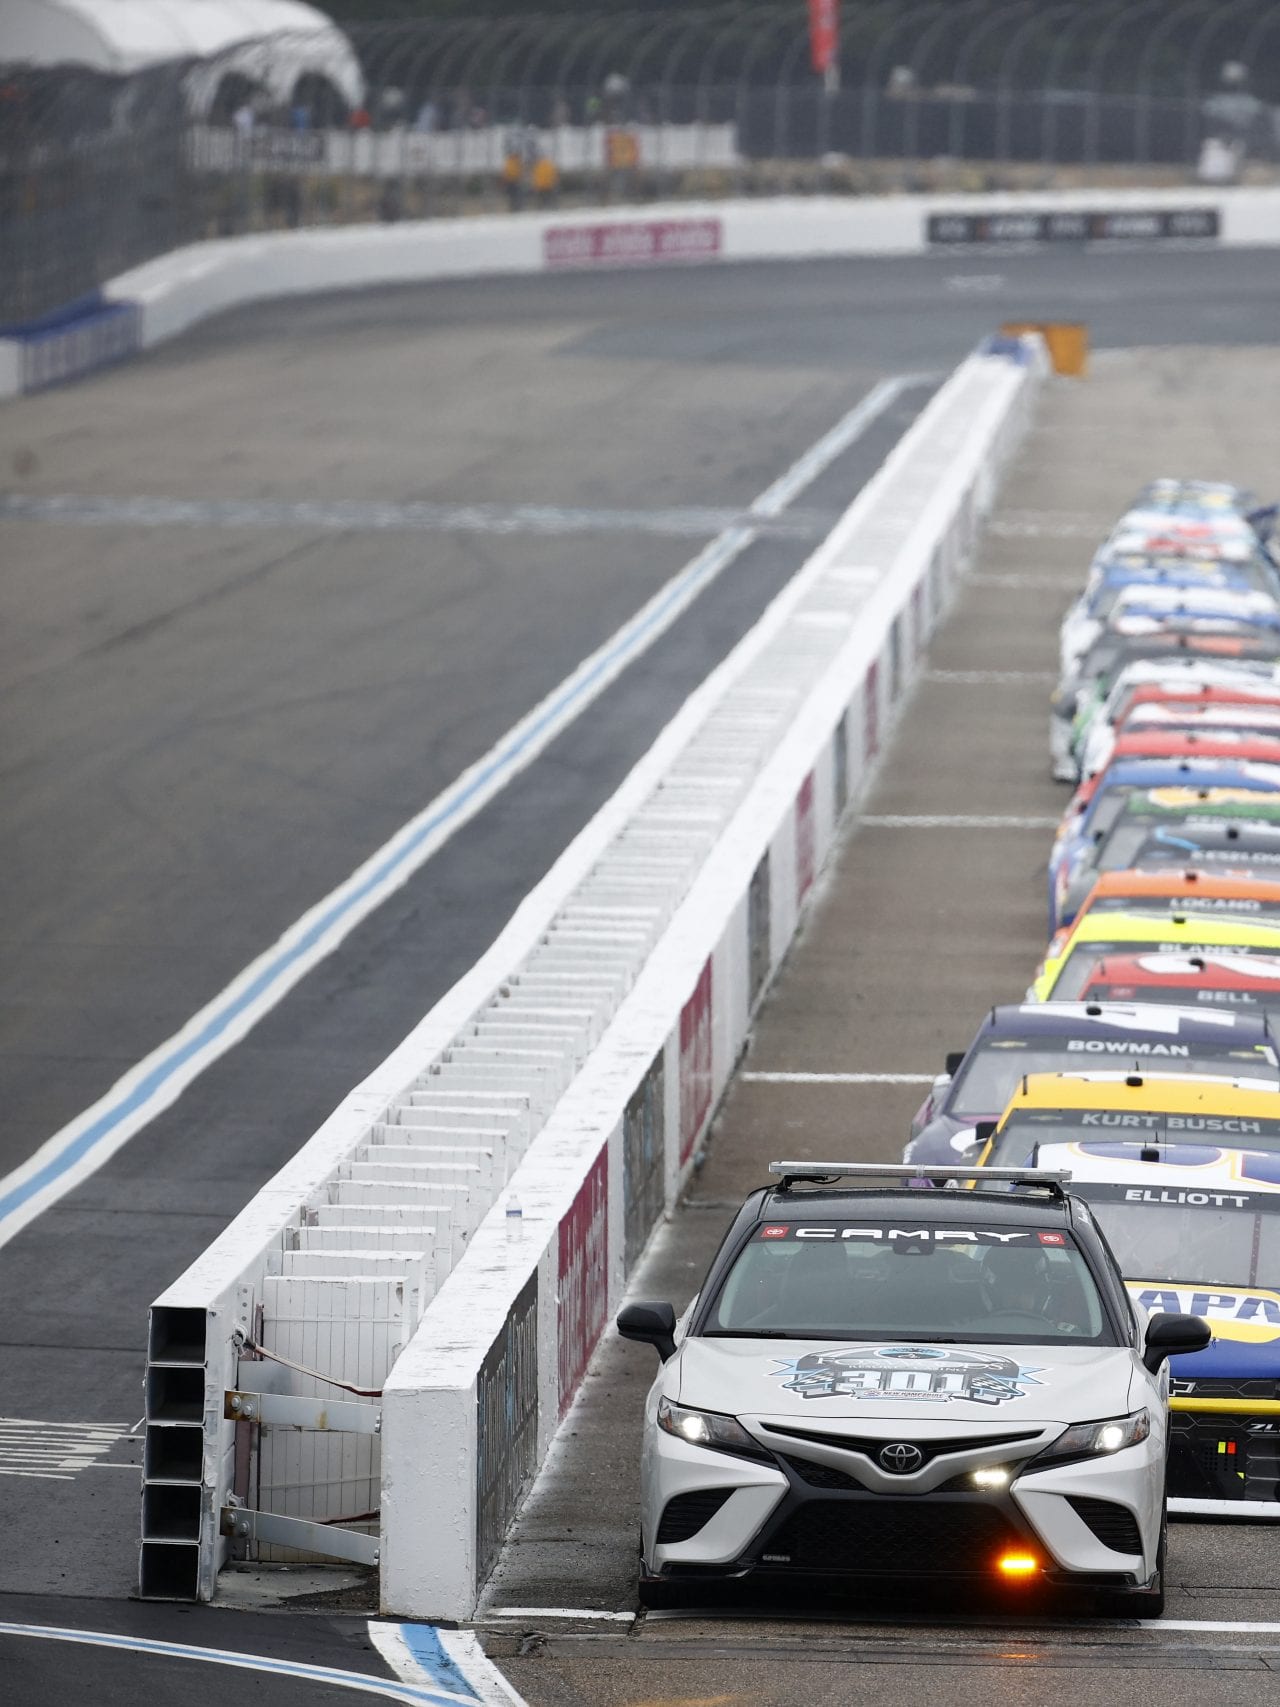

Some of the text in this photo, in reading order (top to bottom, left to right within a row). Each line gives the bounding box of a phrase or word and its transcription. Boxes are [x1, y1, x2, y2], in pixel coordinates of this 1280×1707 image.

[1197, 990, 1257, 1004] BELL
[1067, 1040, 1190, 1057] BOWMAN
[1082, 1113, 1261, 1134] KURT BUSCH
[1125, 1189, 1250, 1208] ELLIOTT
[796, 1228, 1031, 1242] CAMRY
[836, 1370, 970, 1393] 301
